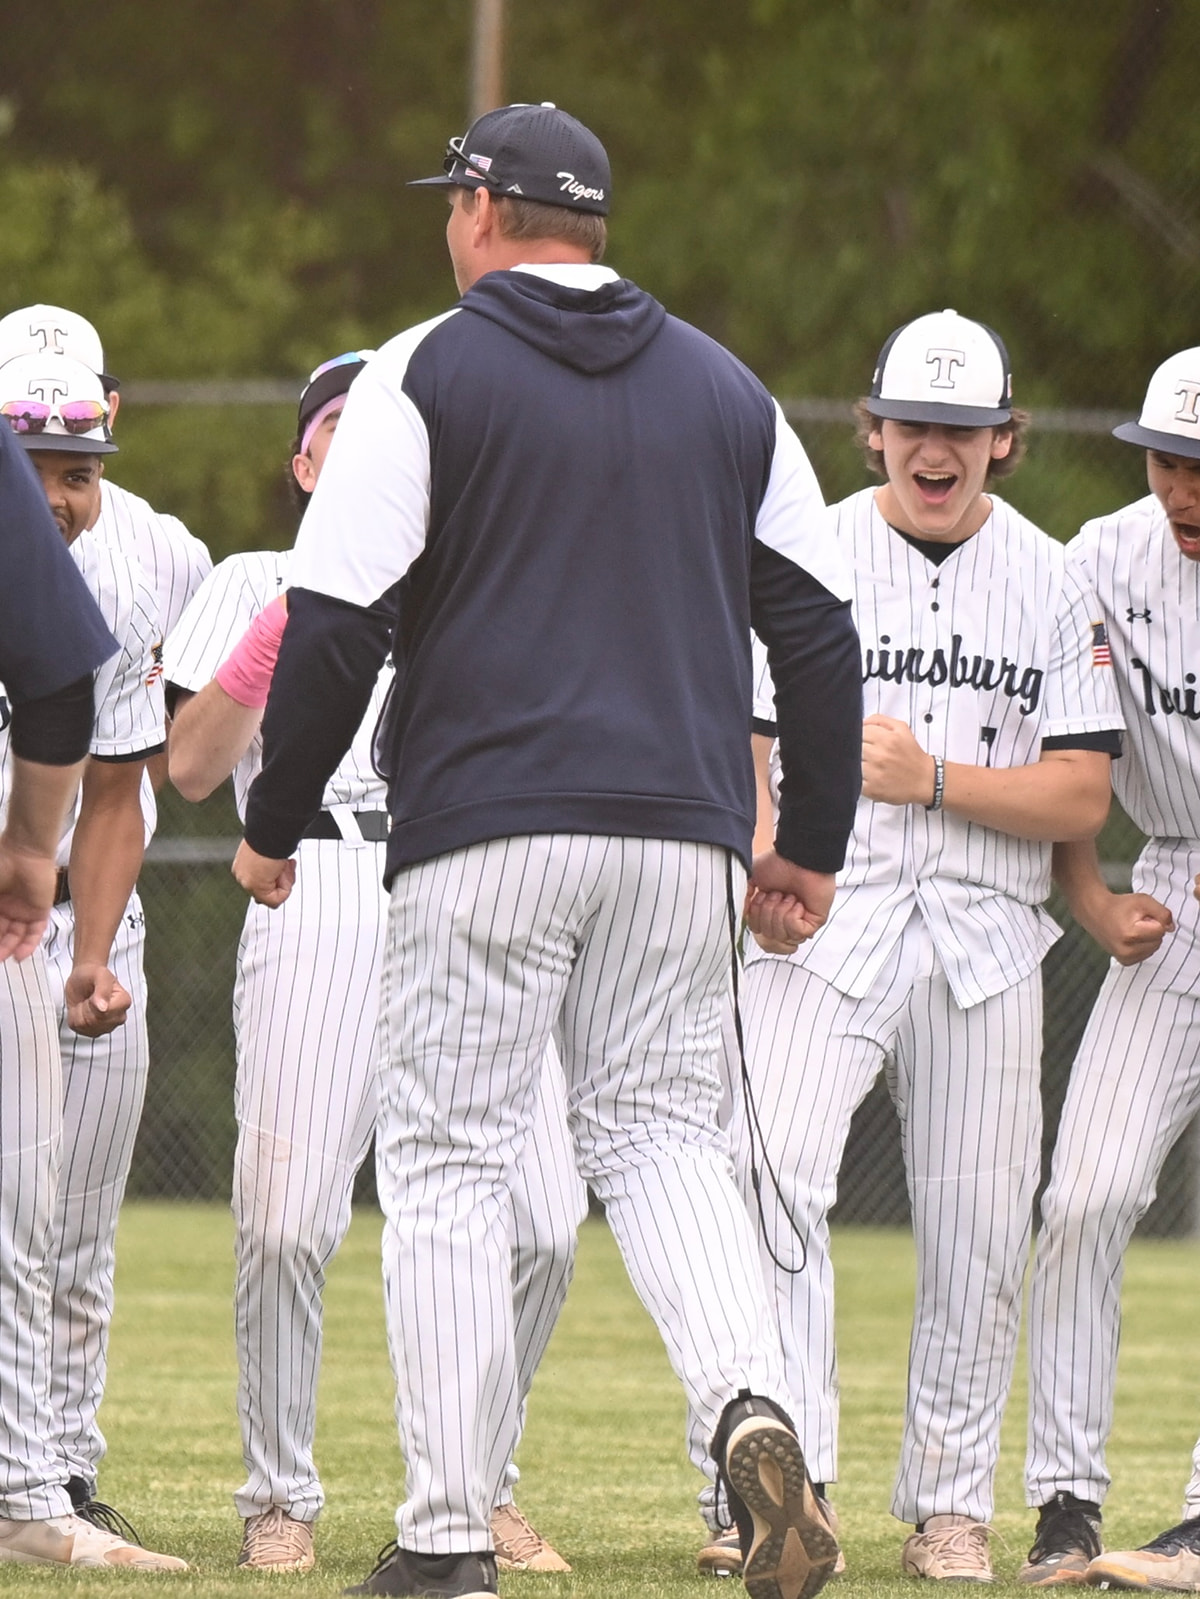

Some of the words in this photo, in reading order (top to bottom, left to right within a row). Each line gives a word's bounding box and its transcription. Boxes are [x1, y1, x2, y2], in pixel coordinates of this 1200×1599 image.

[556, 172, 605, 201] Tigers
[29, 320, 68, 355] T
[926, 348, 965, 389] T
[862, 634, 1044, 716] insburg
